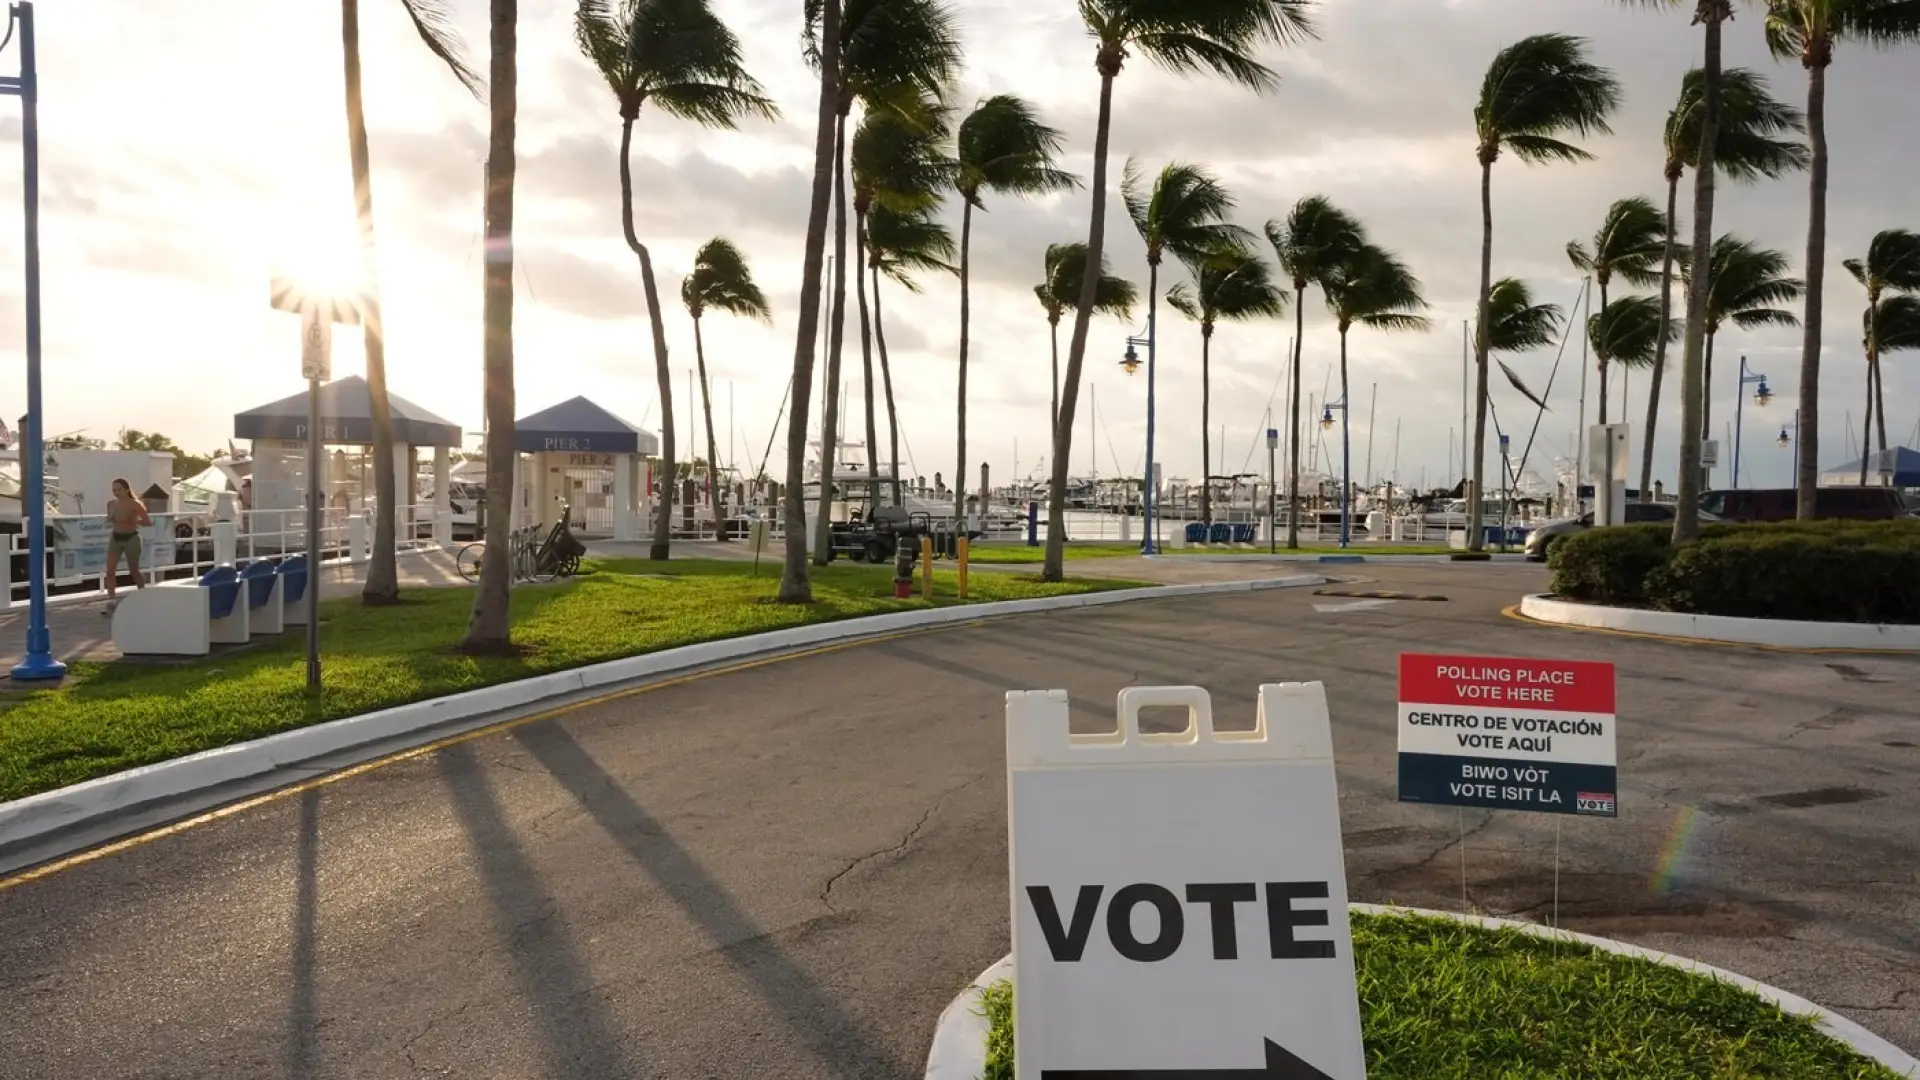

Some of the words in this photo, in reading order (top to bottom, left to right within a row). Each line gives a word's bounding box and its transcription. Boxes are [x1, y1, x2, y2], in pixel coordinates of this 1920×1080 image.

[544, 437, 578, 450] PIER
[583, 438, 591, 450] 2
[570, 453, 597, 465] PIER
[604, 454, 612, 465] 2
[1437, 665, 1511, 682] POLLING
[1516, 668, 1575, 685] PLACE
[1456, 685, 1502, 700] VOTE
[1507, 686, 1555, 702] HERE
[1408, 711, 1479, 729] CENTRO
[1484, 715, 1507, 731] DE
[1512, 717, 1603, 736] VOTACIÓN
[1457, 733, 1504, 749] VOTE
[1508, 736, 1552, 753] AQUÍ
[1461, 764, 1508, 781] BIWO
[1513, 765, 1550, 783] VÒT
[1450, 782, 1497, 799] VOTE
[1502, 786, 1533, 801] ISIT
[1538, 788, 1562, 804] LA
[1578, 799, 1614, 811] VOTE
[1025, 881, 1336, 962] VOTE
